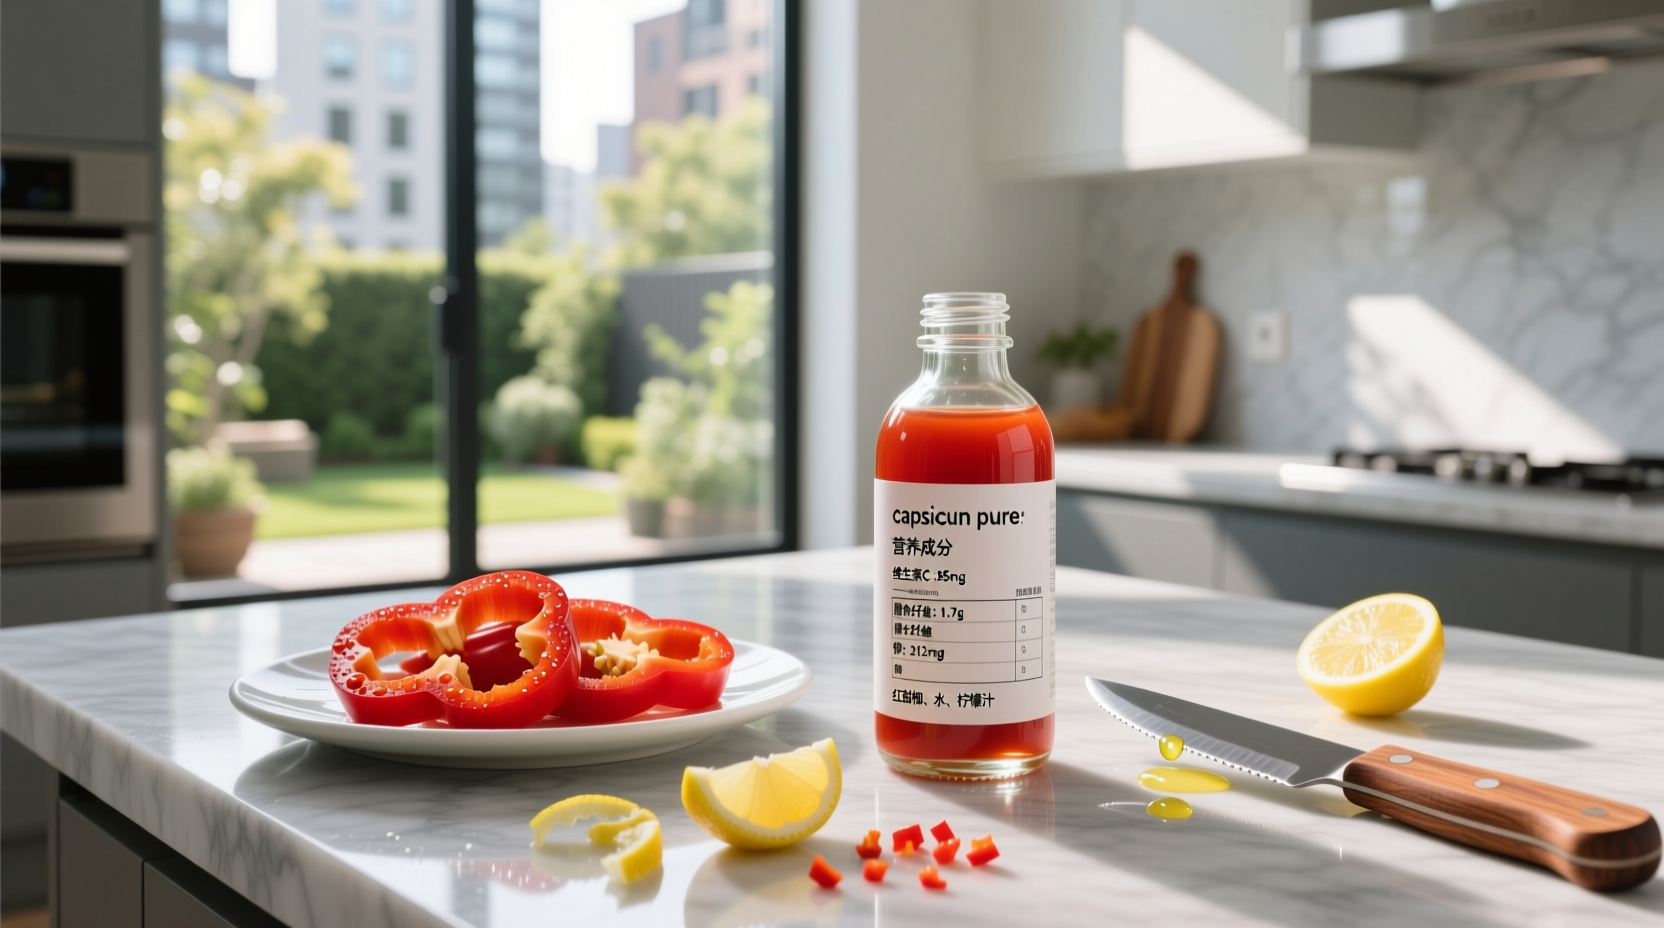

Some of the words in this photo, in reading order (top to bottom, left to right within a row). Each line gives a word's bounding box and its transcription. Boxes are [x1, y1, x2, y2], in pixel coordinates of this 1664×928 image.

[892, 505, 971, 529] capsicun
[892, 536, 953, 557] 营养成分
